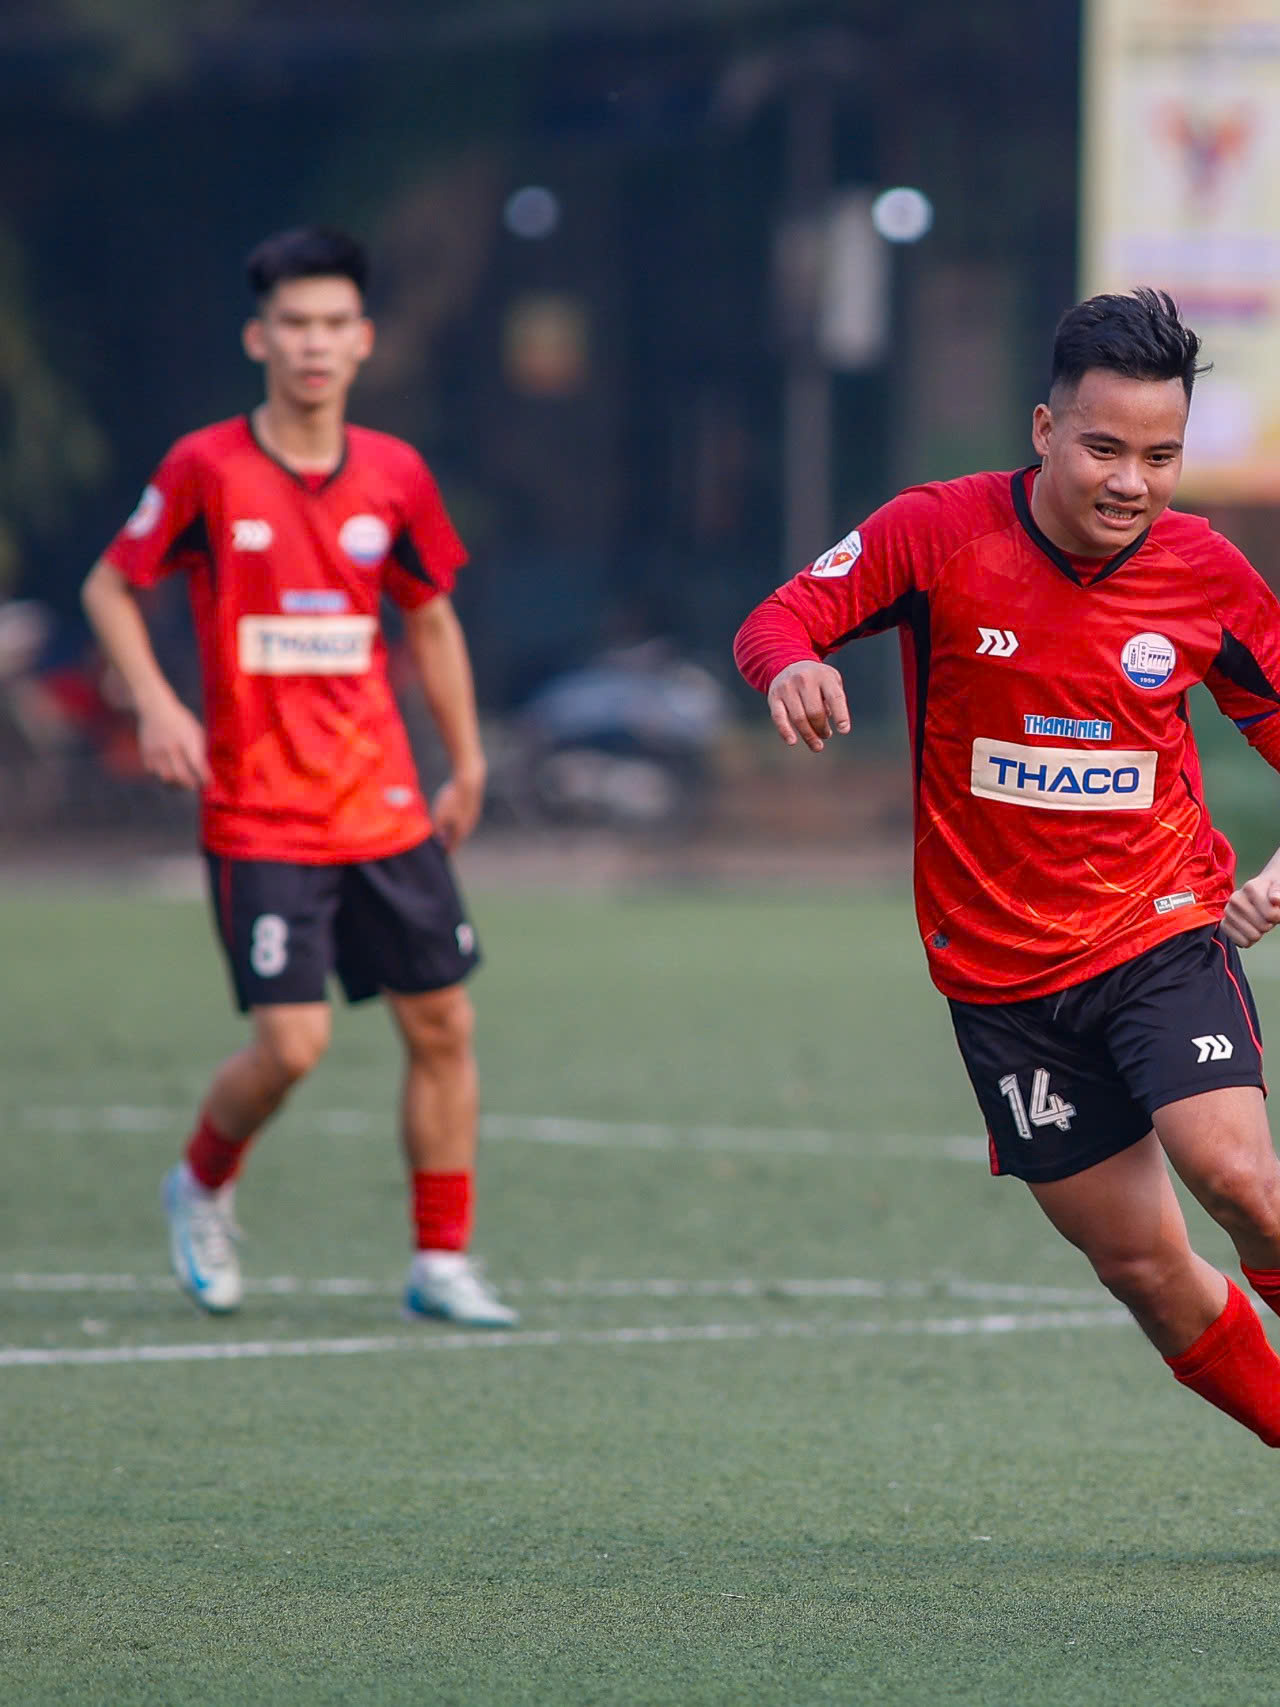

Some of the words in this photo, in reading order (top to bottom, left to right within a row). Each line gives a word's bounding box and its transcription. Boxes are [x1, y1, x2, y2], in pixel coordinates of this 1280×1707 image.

[1024, 715, 1076, 737] THANH
[989, 756, 1140, 794] THACO
[251, 914, 289, 977] 8
[998, 1067, 1077, 1140] 14
